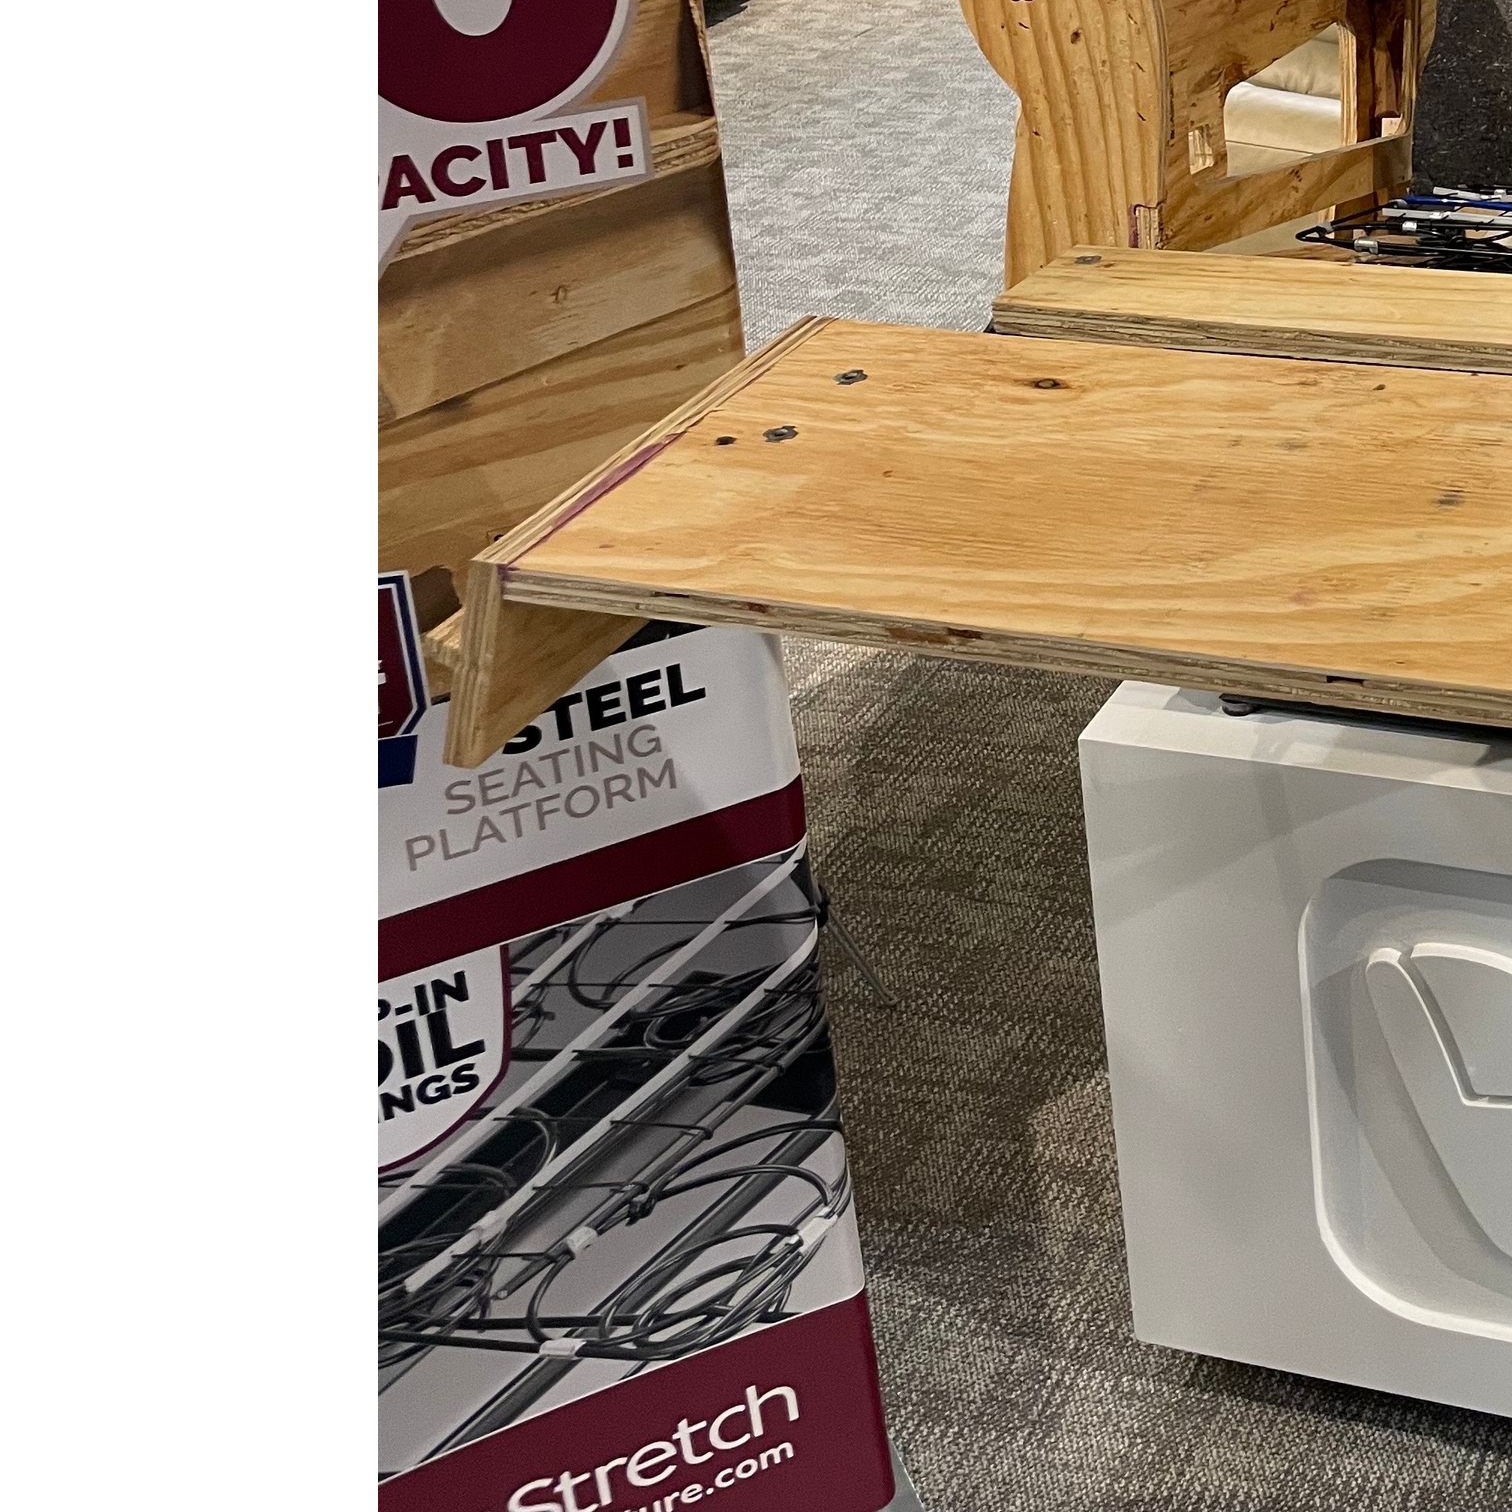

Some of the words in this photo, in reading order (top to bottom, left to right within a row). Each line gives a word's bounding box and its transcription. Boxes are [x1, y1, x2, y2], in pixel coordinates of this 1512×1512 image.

[378, 118, 635, 211] ACITY!
[404, 758, 679, 873] PLATFORM
[444, 723, 664, 816] SEATING
